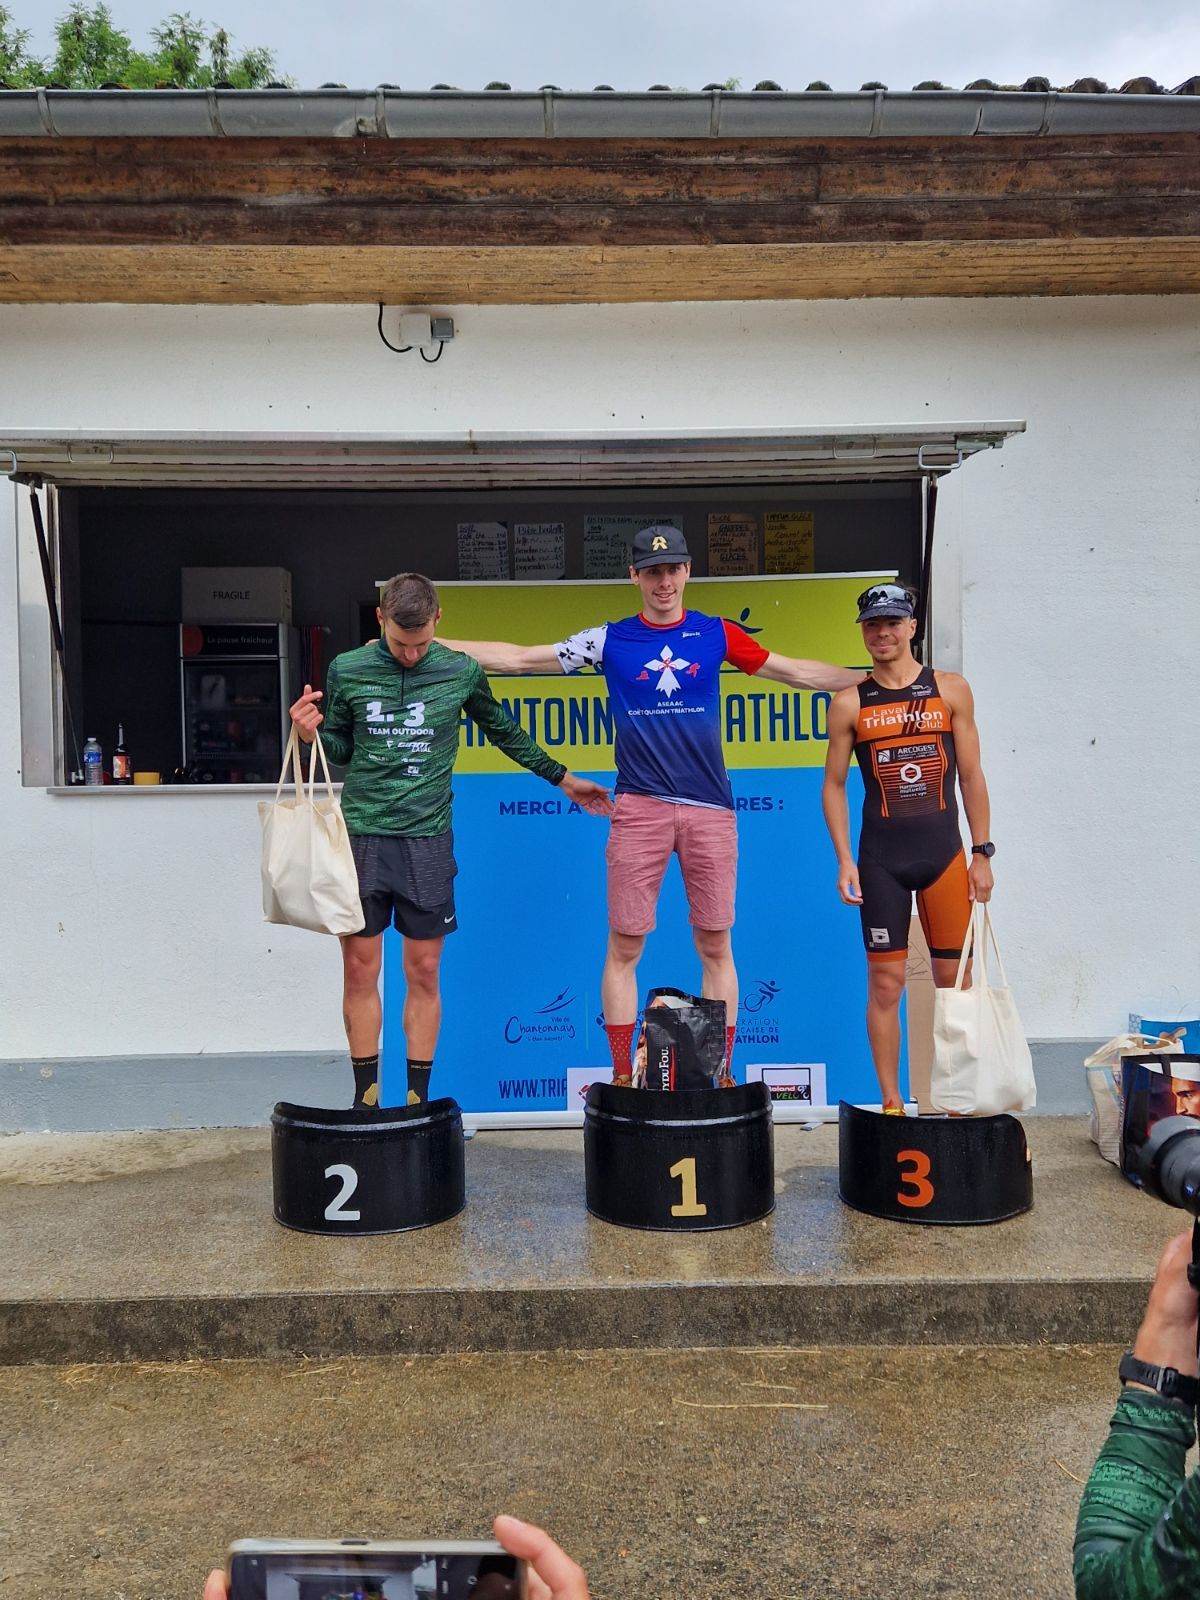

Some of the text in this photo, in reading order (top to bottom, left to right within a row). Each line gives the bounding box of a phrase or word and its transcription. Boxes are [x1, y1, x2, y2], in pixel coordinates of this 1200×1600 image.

[213, 591, 251, 600] FRAGILE
[873, 706, 906, 717] Laval
[863, 711, 943, 729] Triathlon
[916, 720, 943, 730] Club
[368, 727, 390, 735] TEAM
[897, 745, 936, 754] ARCOGEST
[499, 800, 562, 815] MERCI
[505, 1016, 577, 1043] Chantonnay
[669, 1157, 708, 1217] 1
[896, 1150, 935, 1209] 3
[324, 1164, 361, 1221] 2
